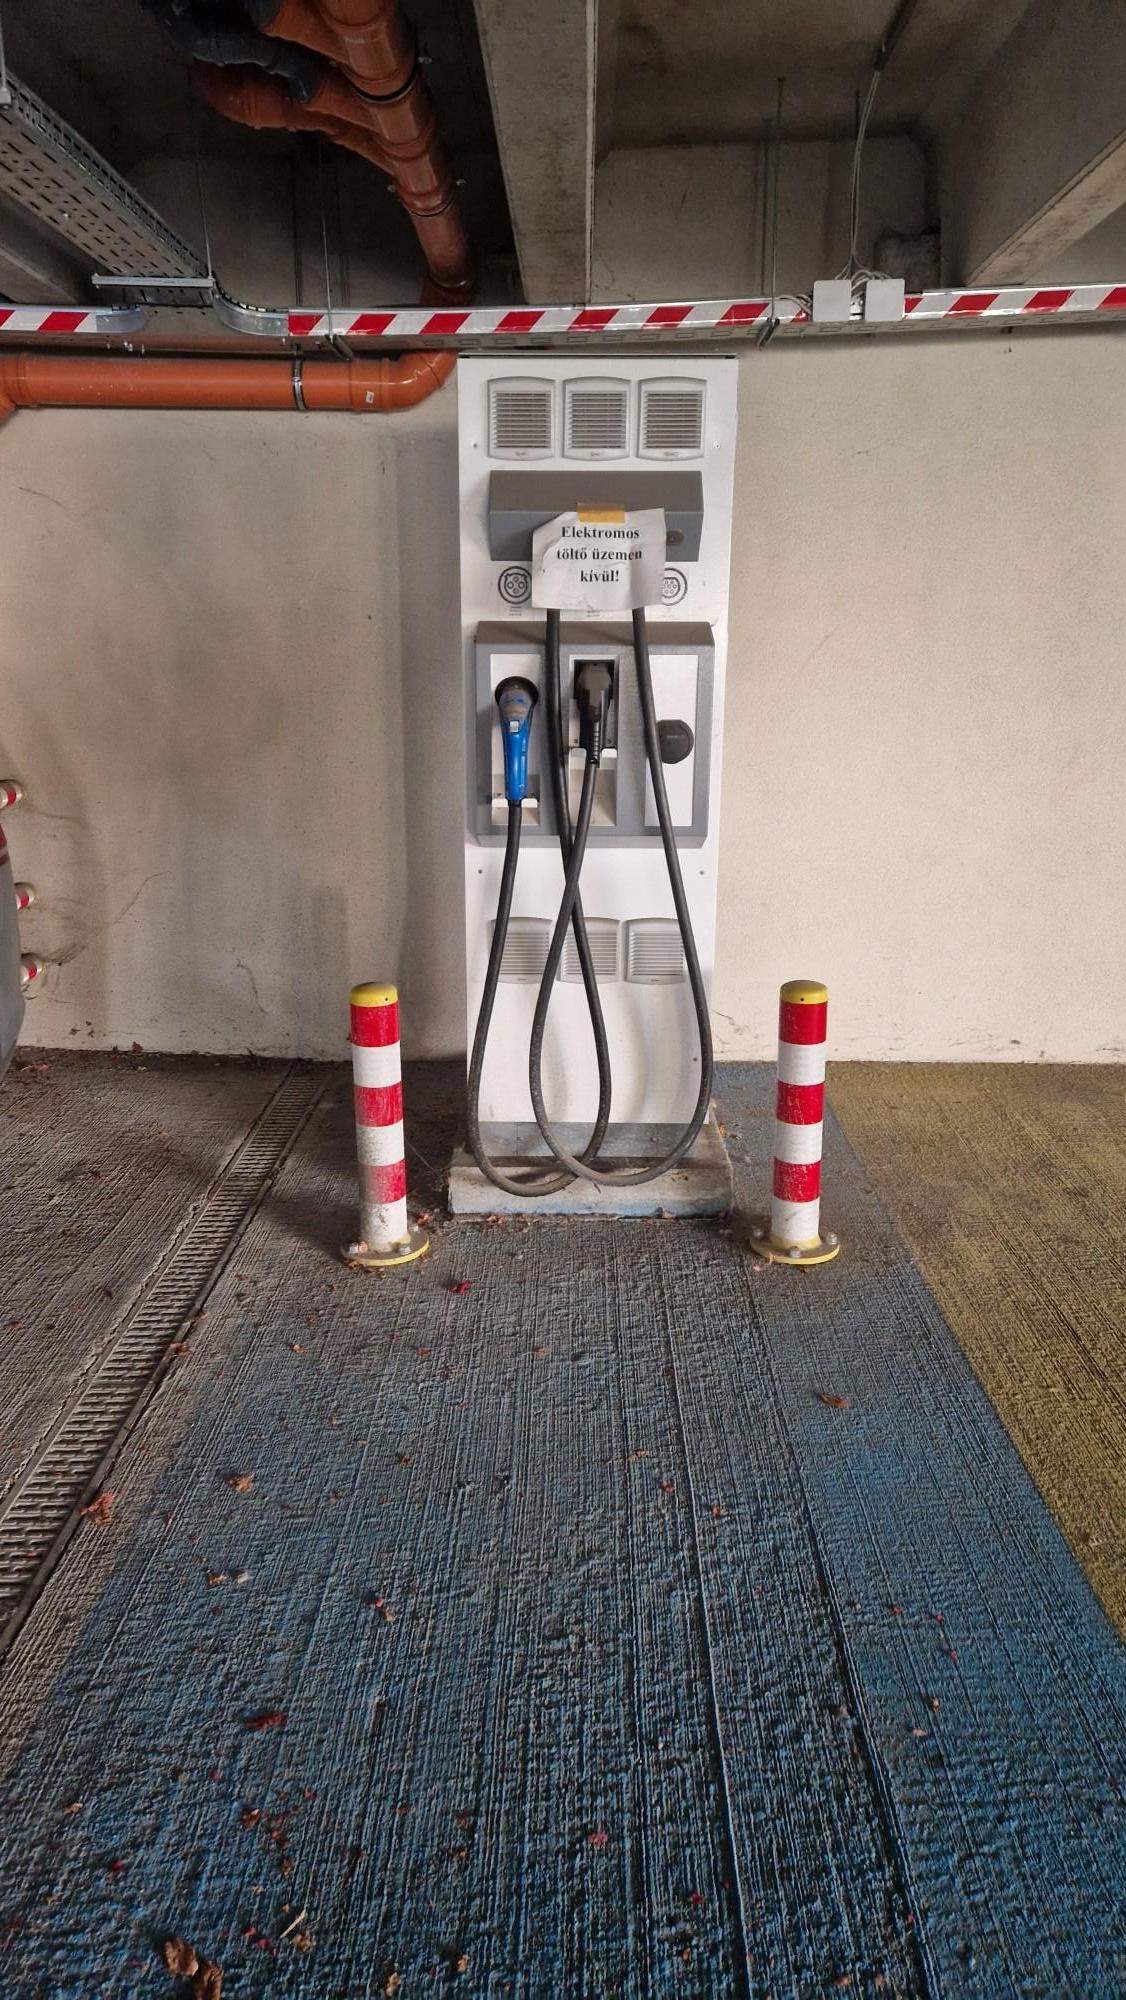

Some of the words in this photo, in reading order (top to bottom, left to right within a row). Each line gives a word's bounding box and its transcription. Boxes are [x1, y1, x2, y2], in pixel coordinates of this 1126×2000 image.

[561, 526, 640, 539] Elektromos
[592, 548, 642, 560] üzemen
[580, 570, 619, 582] kívül!
